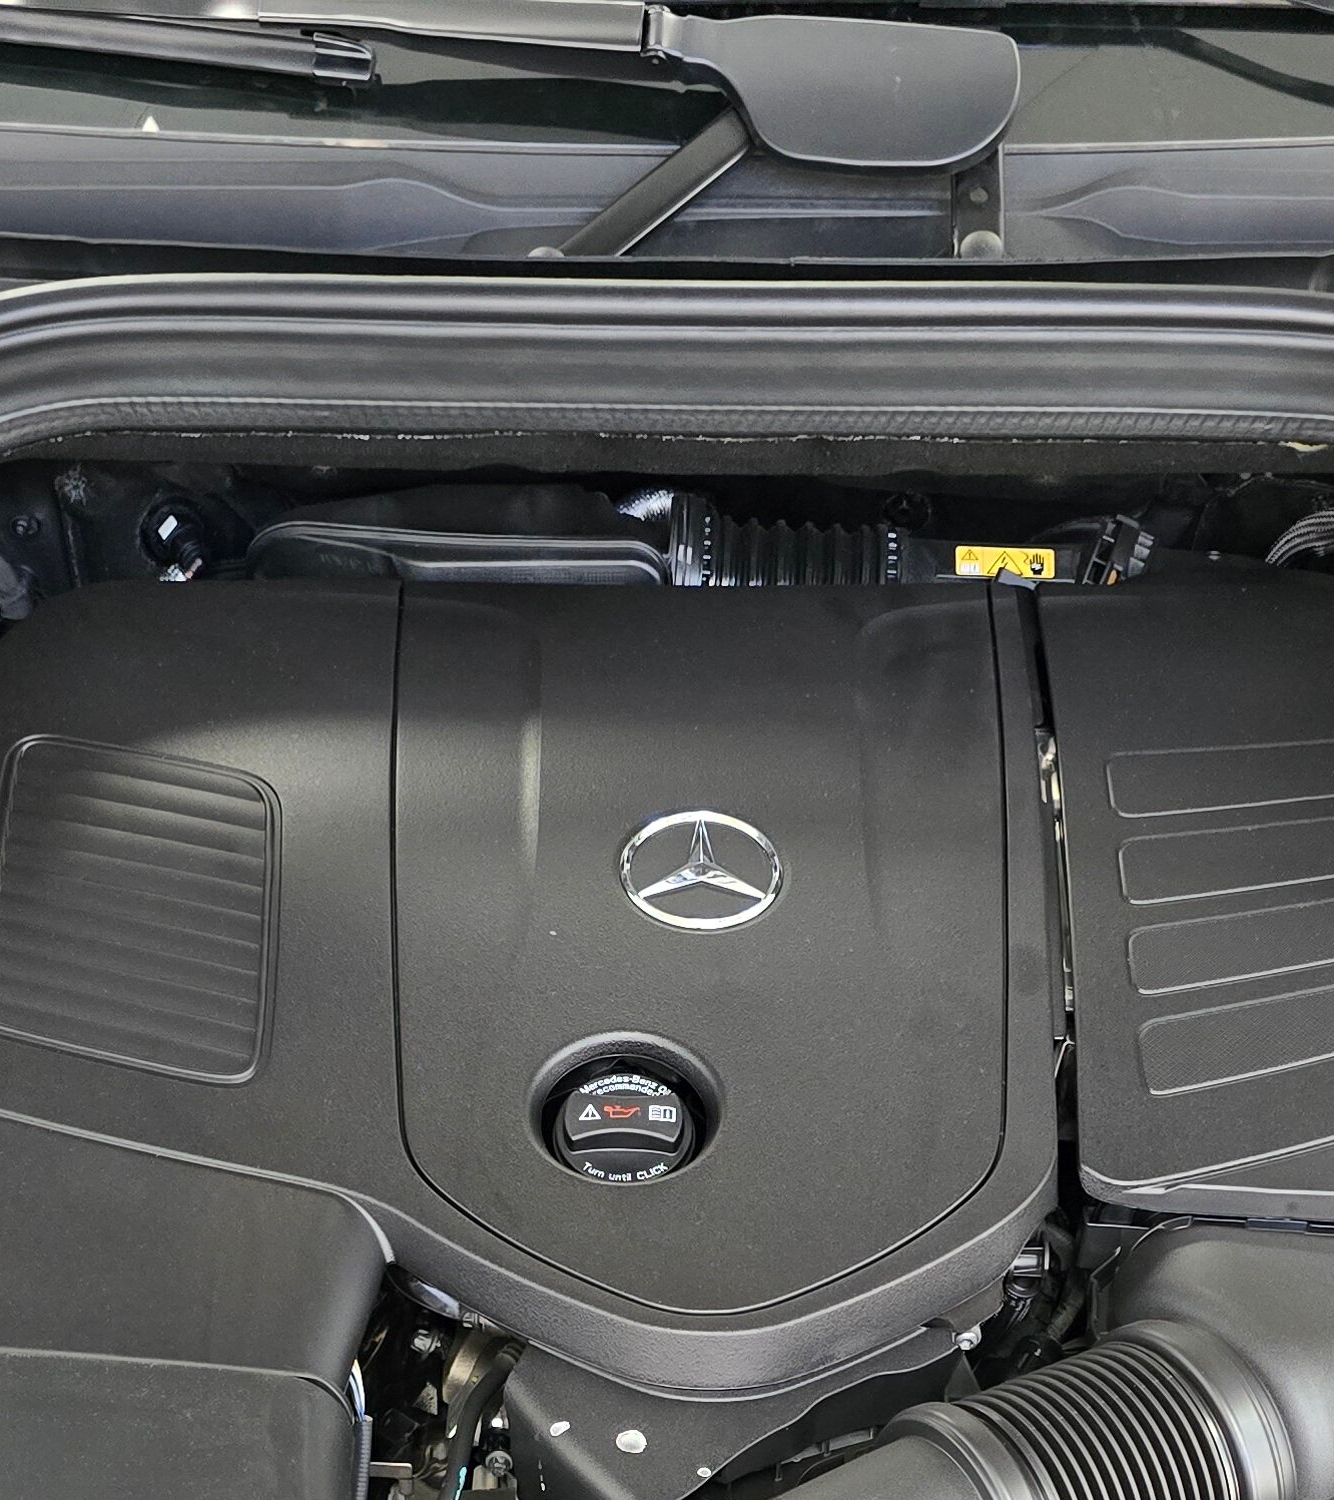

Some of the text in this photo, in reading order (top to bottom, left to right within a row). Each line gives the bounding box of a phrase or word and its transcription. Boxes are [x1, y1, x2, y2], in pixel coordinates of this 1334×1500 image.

[579, 1075, 658, 1094] Mercedes-Benz
[582, 1162, 669, 1181] Turn until CLICK
